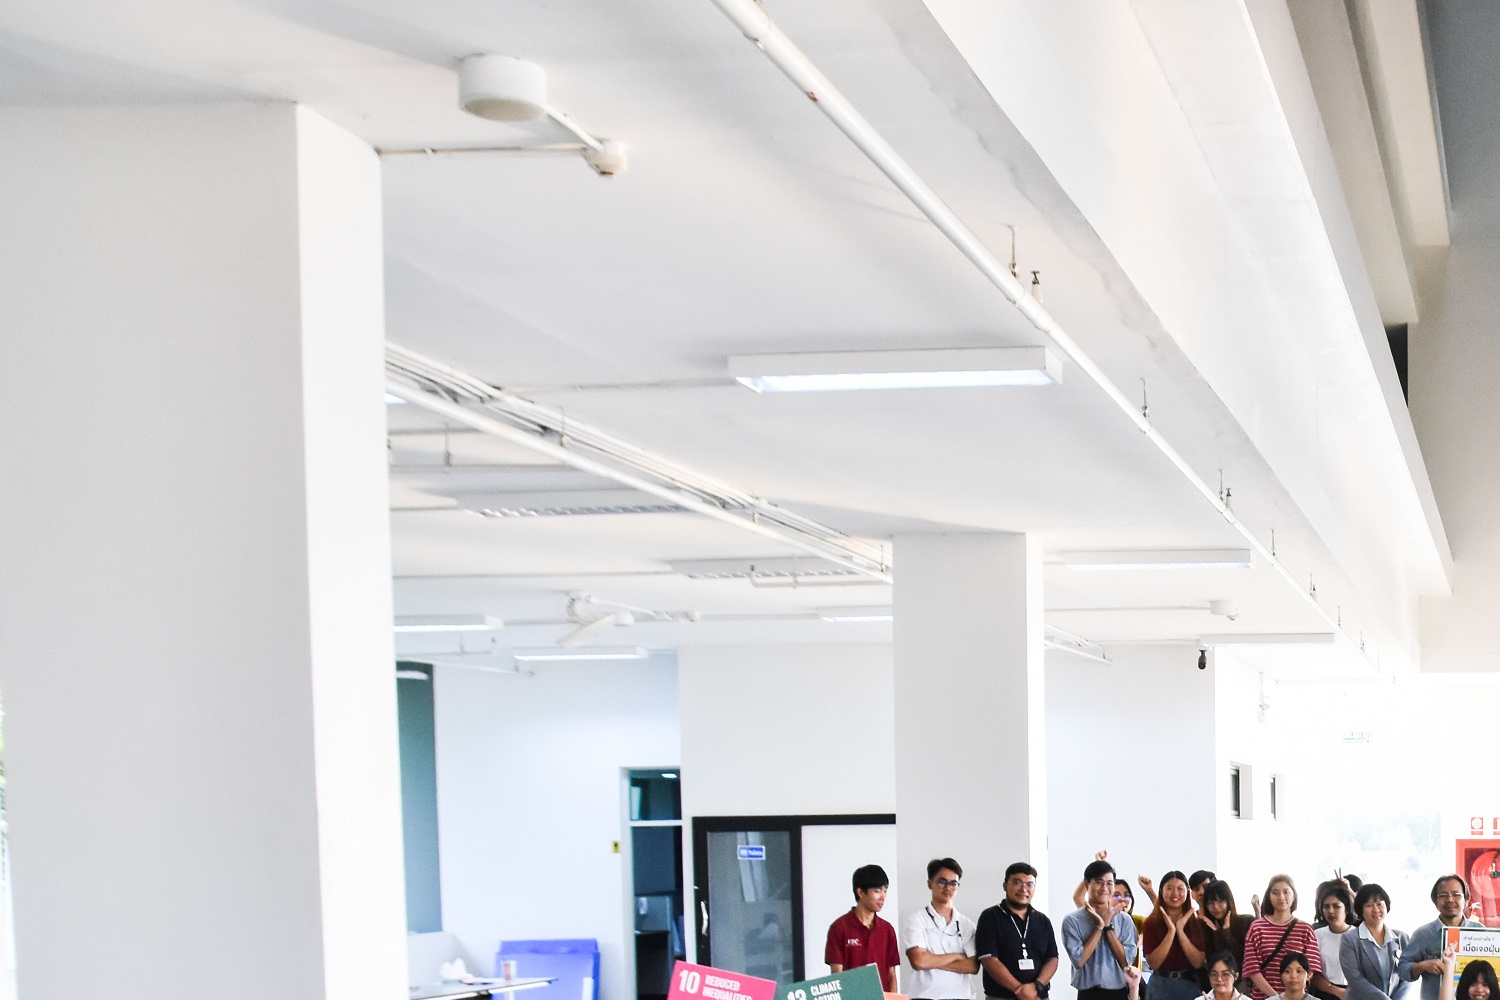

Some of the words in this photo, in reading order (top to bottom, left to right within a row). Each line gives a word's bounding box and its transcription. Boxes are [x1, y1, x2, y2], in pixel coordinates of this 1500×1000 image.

[679, 969, 700, 995] 10
[704, 974, 741, 992] REDUCED
[810, 980, 842, 997] CLIMATE
